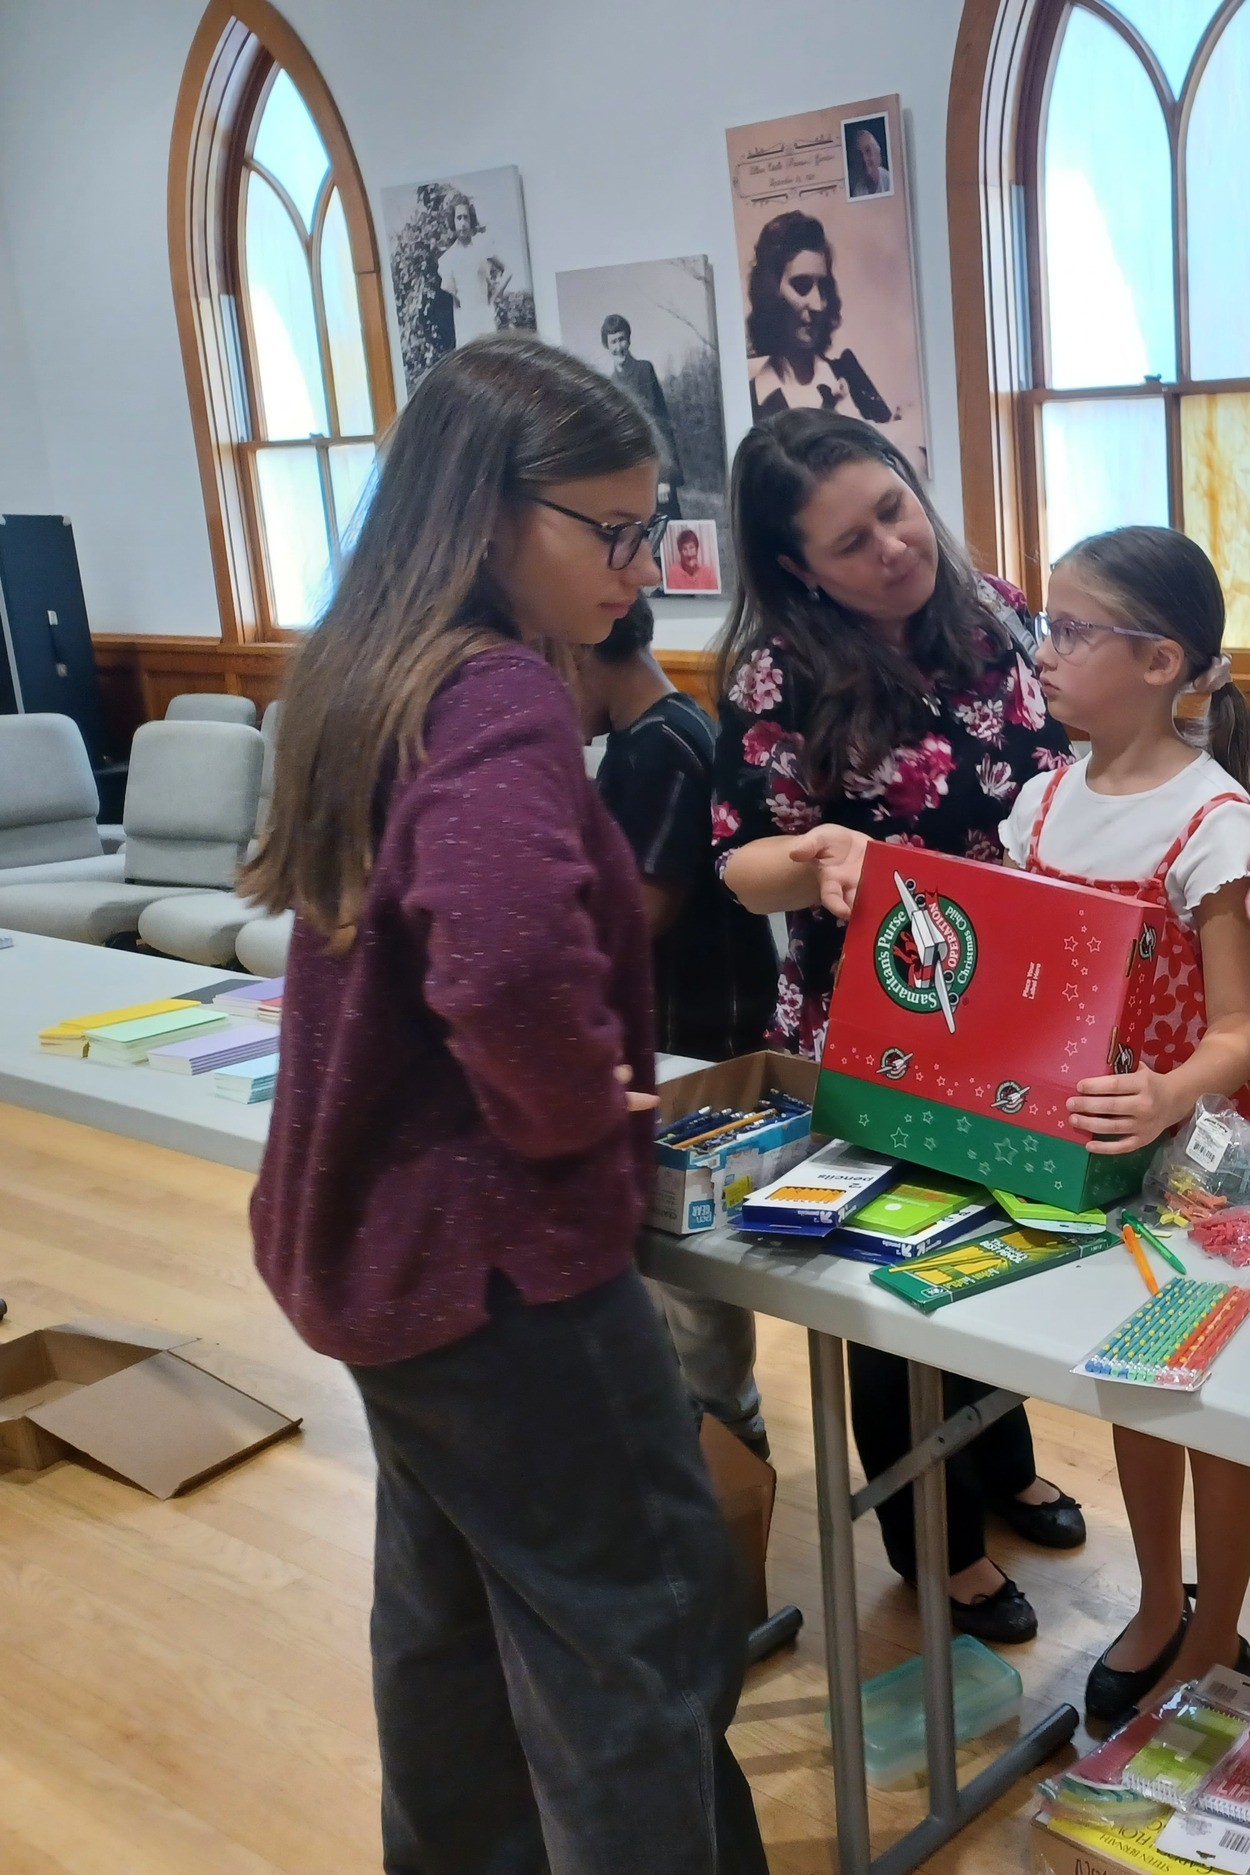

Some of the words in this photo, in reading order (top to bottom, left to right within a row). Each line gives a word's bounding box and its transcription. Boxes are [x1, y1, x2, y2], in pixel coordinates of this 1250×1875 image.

[877, 910, 907, 949] Purse
[928, 902, 959, 968] OPERATION
[945, 906, 967, 931] Child
[957, 930, 974, 984] Christmas
[877, 951, 938, 1008] Samaritan's
[1022, 979, 1031, 997] Place
[1027, 961, 1035, 977] Your
[1028, 980, 1038, 999] Label
[1033, 963, 1041, 979] Here
[817, 1174, 874, 1182] pencils
[692, 1204, 710, 1217] GEAR
[696, 1211, 712, 1224] pen
